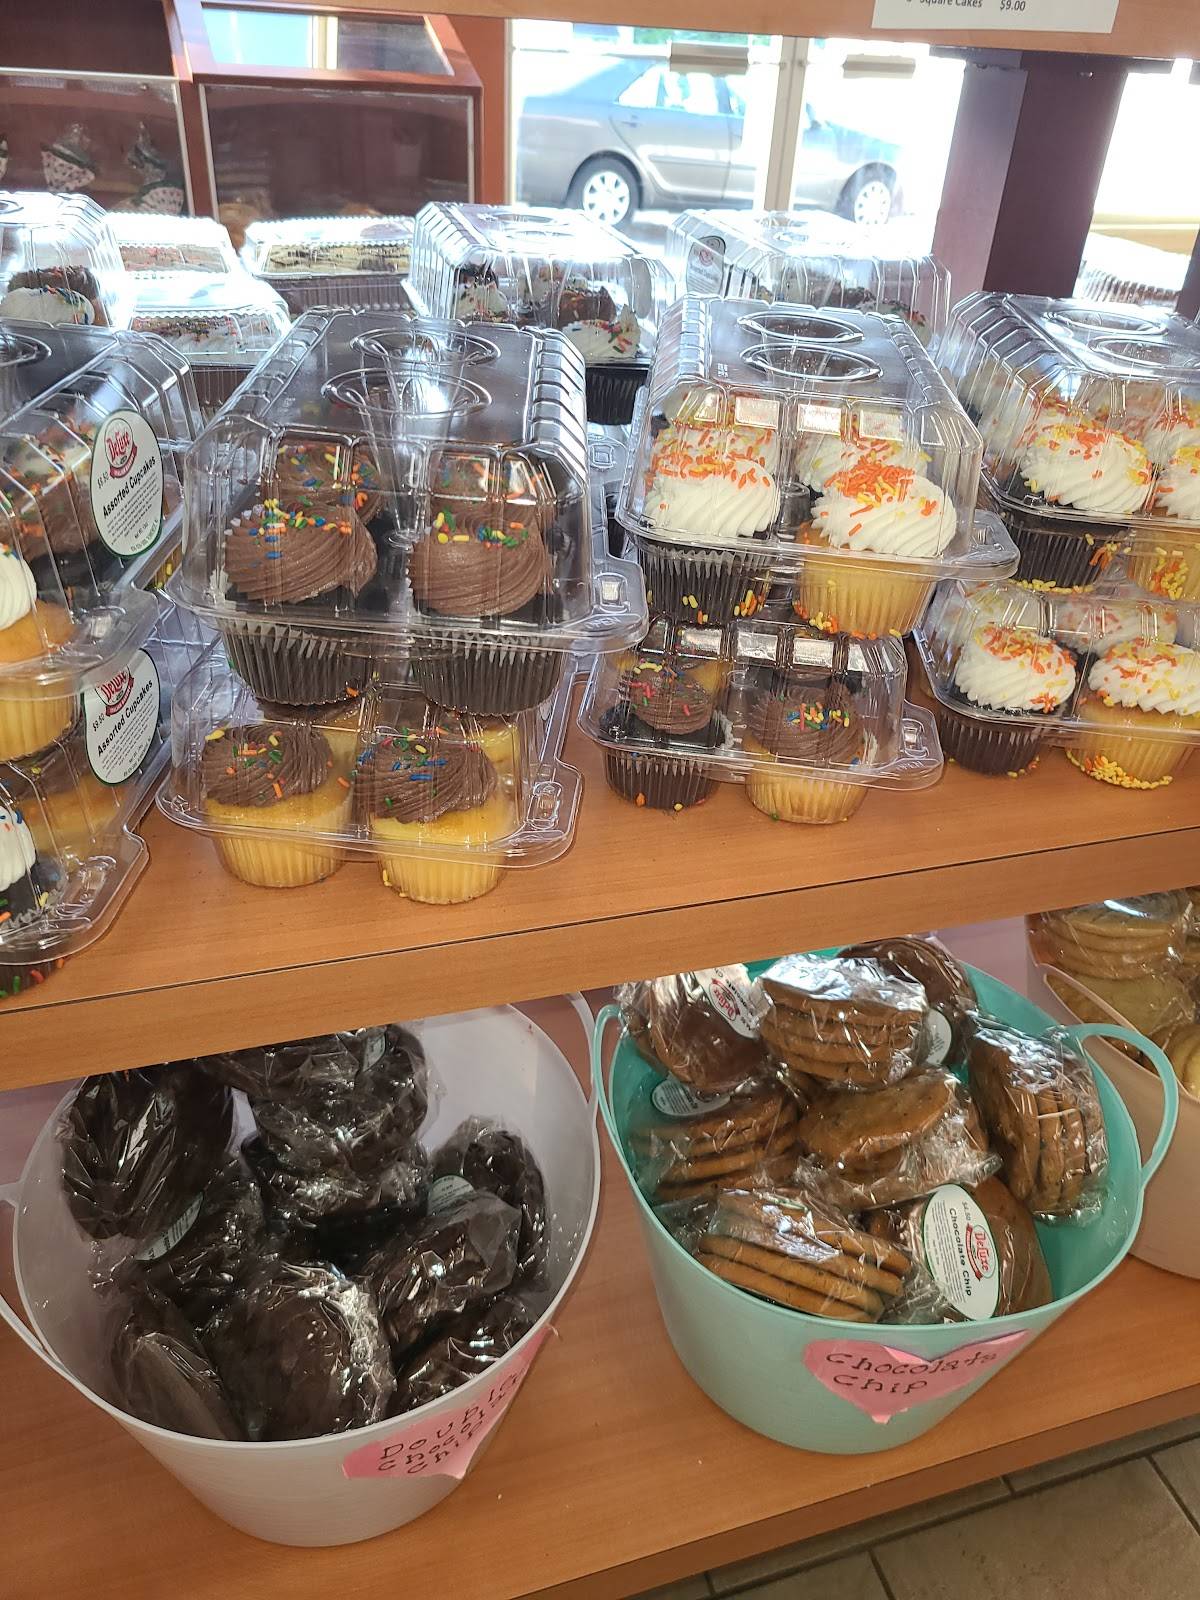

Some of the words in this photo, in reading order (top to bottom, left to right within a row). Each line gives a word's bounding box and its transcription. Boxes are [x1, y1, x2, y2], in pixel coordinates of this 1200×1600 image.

[1000, 0, 1026, 12] $9.00
[103, 481, 130, 520] Assorted
[129, 456, 156, 485] Cupcakes
[97, 715, 126, 758] Assorted
[125, 680, 153, 719] Cupcakes
[949, 1207, 966, 1266] Chocolate
[962, 1270, 972, 1297] Chip
